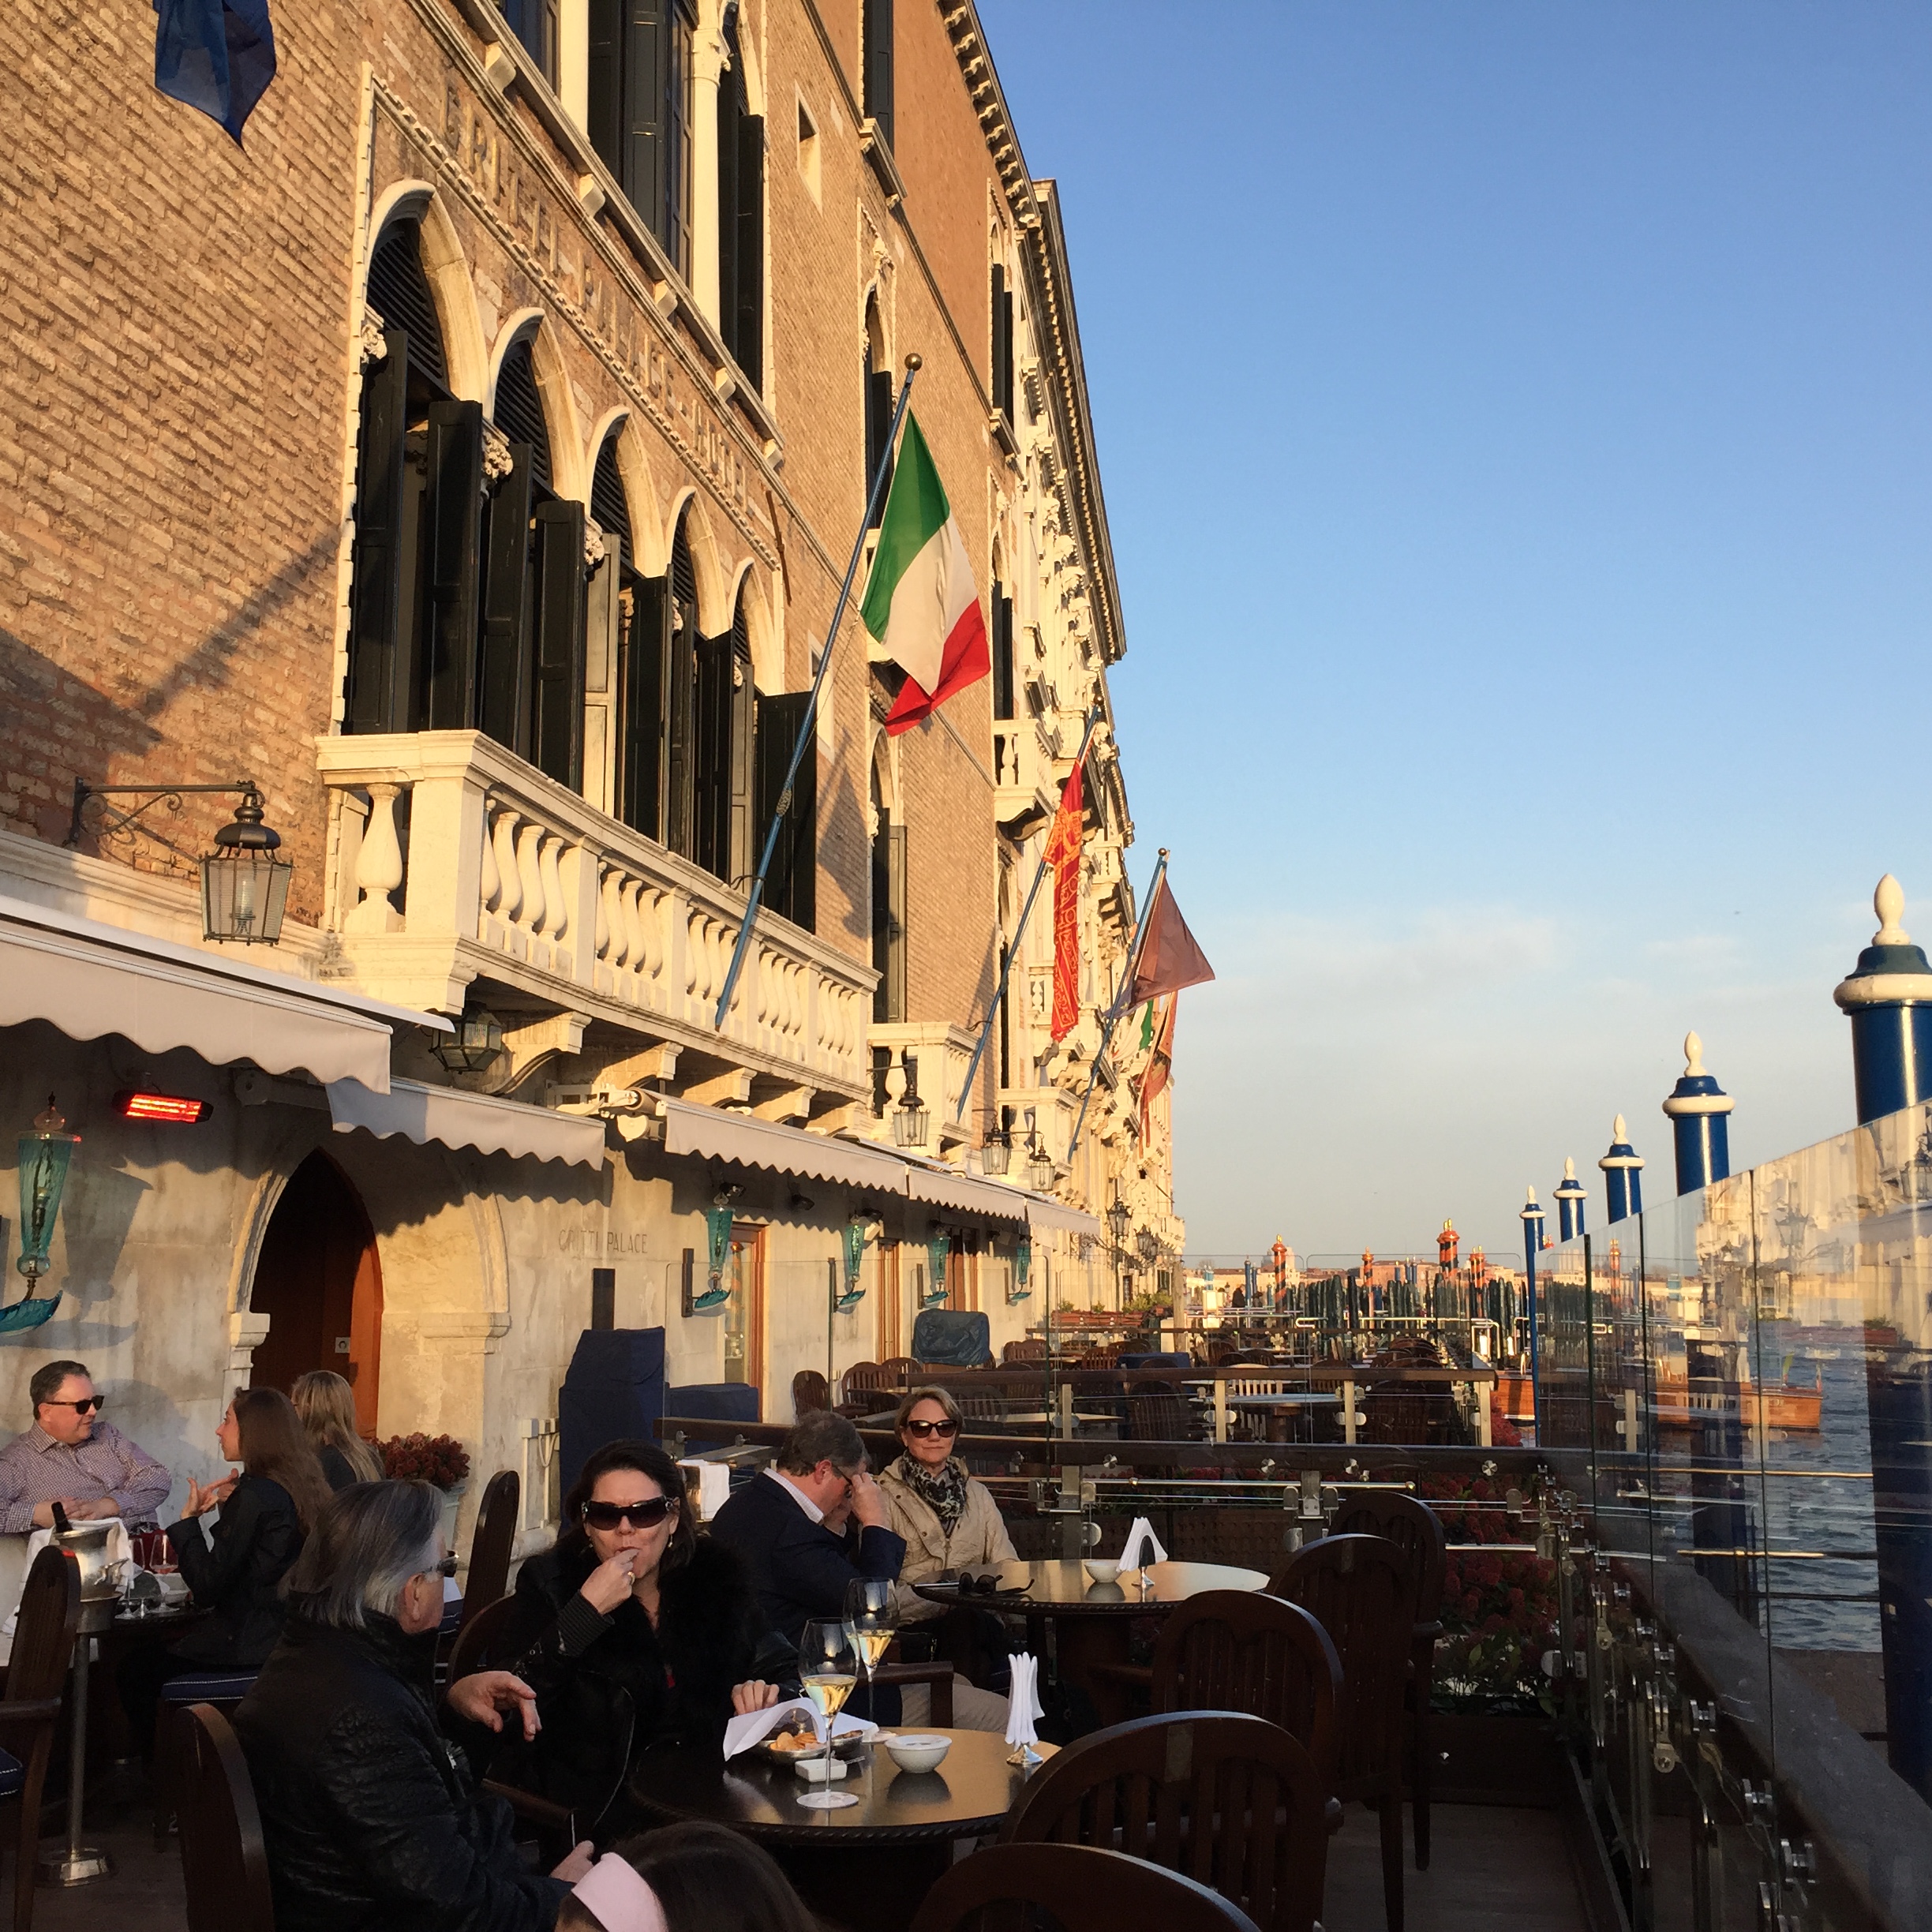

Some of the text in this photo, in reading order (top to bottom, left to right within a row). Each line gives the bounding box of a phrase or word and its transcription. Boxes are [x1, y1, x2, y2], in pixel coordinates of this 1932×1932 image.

[439, 79, 560, 278] GRITTI
[558, 1229, 648, 1254] GRITTI PALACE
